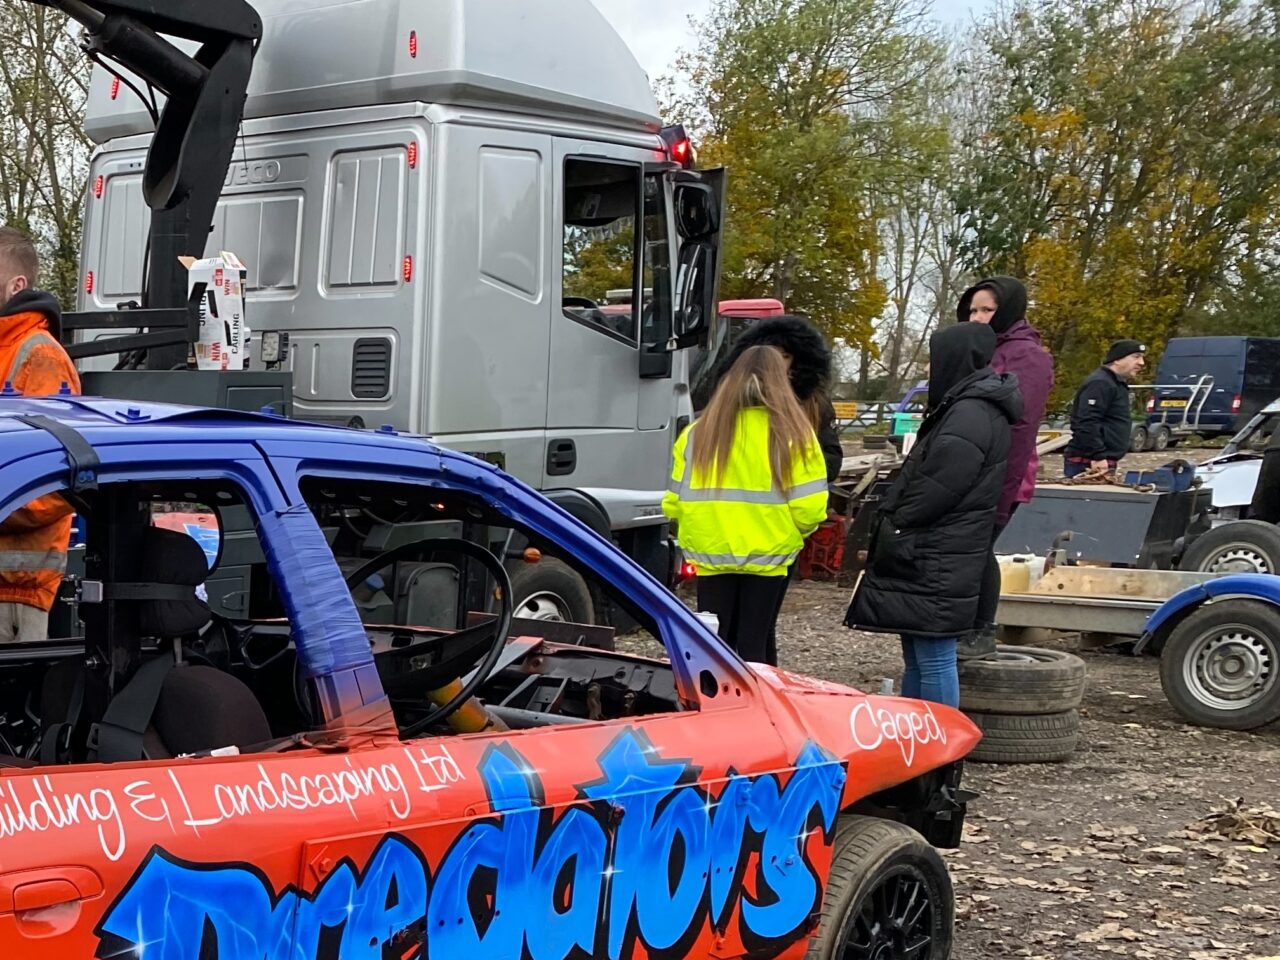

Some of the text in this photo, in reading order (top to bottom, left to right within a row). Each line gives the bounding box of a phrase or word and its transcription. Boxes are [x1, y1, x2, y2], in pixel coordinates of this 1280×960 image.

[223, 161, 281, 187] VECO
[211, 342, 222, 362] WIN
[231, 313, 240, 354] CARLING
[850, 699, 947, 767] Caged
[124, 780, 178, 836] &
[167, 755, 410, 838] Landscaping
[405, 743, 467, 793] Ltd
